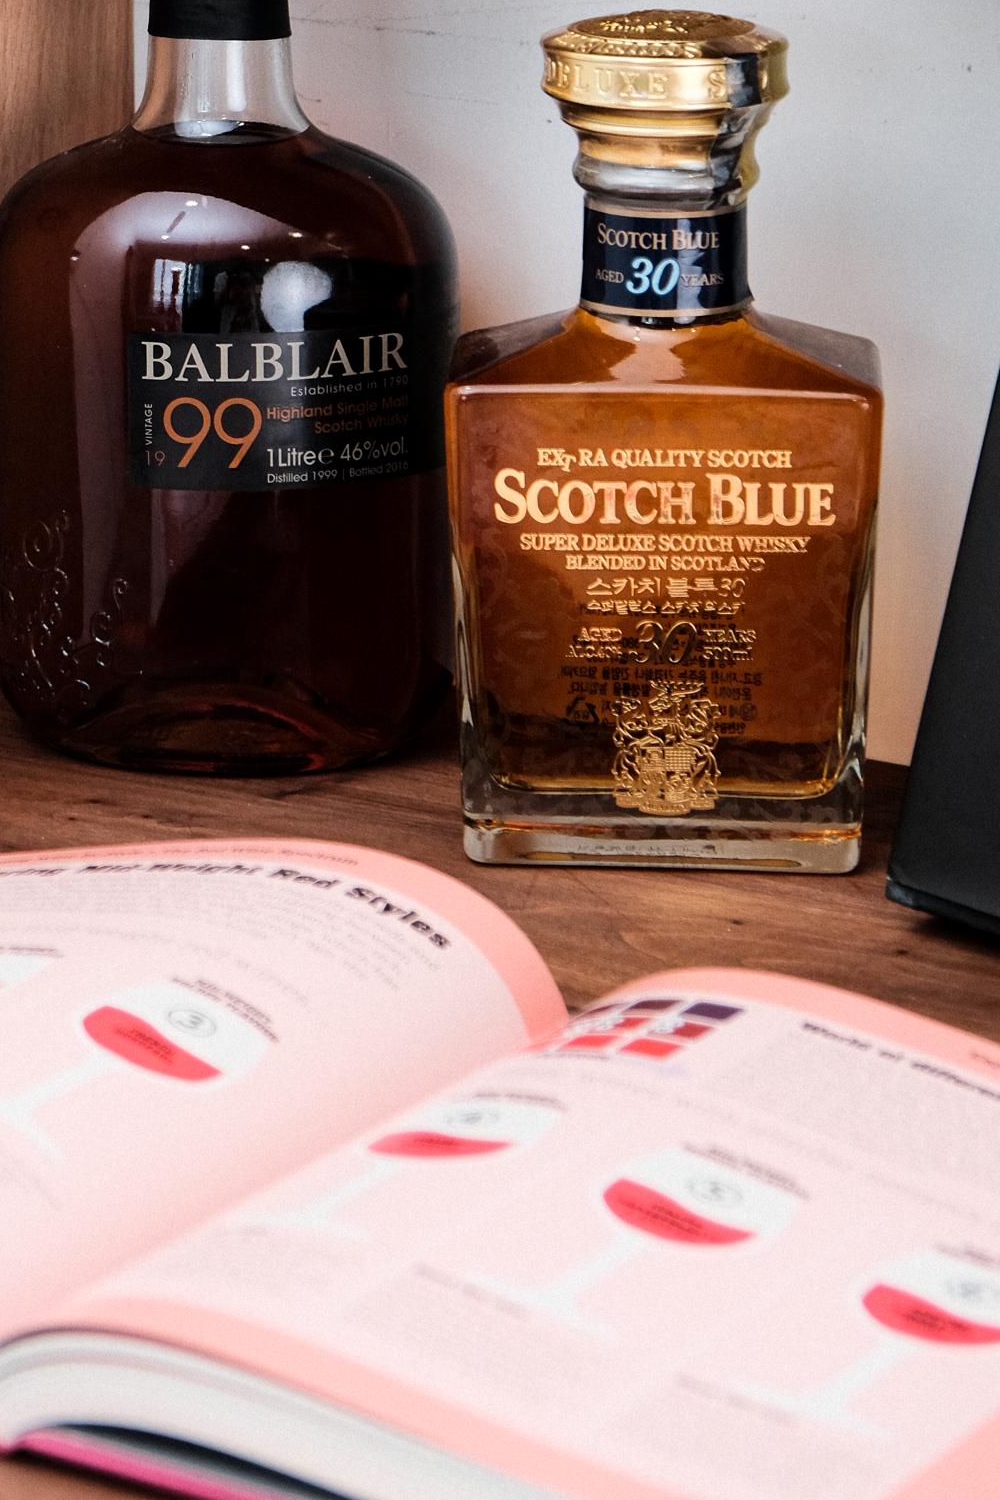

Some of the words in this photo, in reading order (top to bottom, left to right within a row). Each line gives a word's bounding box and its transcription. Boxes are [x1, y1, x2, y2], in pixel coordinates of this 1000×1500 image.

[597, 222, 667, 250] SCOTCH
[672, 229, 720, 250] BLUE
[595, 269, 624, 284] AGED
[625, 256, 681, 296] 30
[680, 273, 724, 287] YEARS
[141, 332, 408, 383] BALBLAIR
[290, 382, 362, 397] Established
[266, 404, 333, 422] Highland
[336, 399, 378, 417] Single
[144, 403, 153, 445] VINTAGE
[163, 396, 262, 468] 99
[313, 418, 363, 435] Scotch
[145, 450, 165, 466] 19
[611, 449, 705, 469] QUALITY
[707, 449, 792, 469] SCOTCH
[267, 471, 308, 484] Distilled
[312, 468, 338, 482] 1999
[494, 467, 697, 525] SCOTCH
[705, 473, 836, 526] BLUE
[520, 532, 579, 551] SUPER
[582, 532, 656, 552] DELUXE
[658, 533, 734, 553] SCOTCH
[736, 535, 811, 554] WHISKY
[566, 554, 646, 571] BLENDED
[648, 555, 668, 571] IN
[670, 555, 766, 573] SCOTLAND
[586, 576, 661, 597] 스카치
[267, 868, 342, 890] Red
[344, 885, 451, 950] Styles
